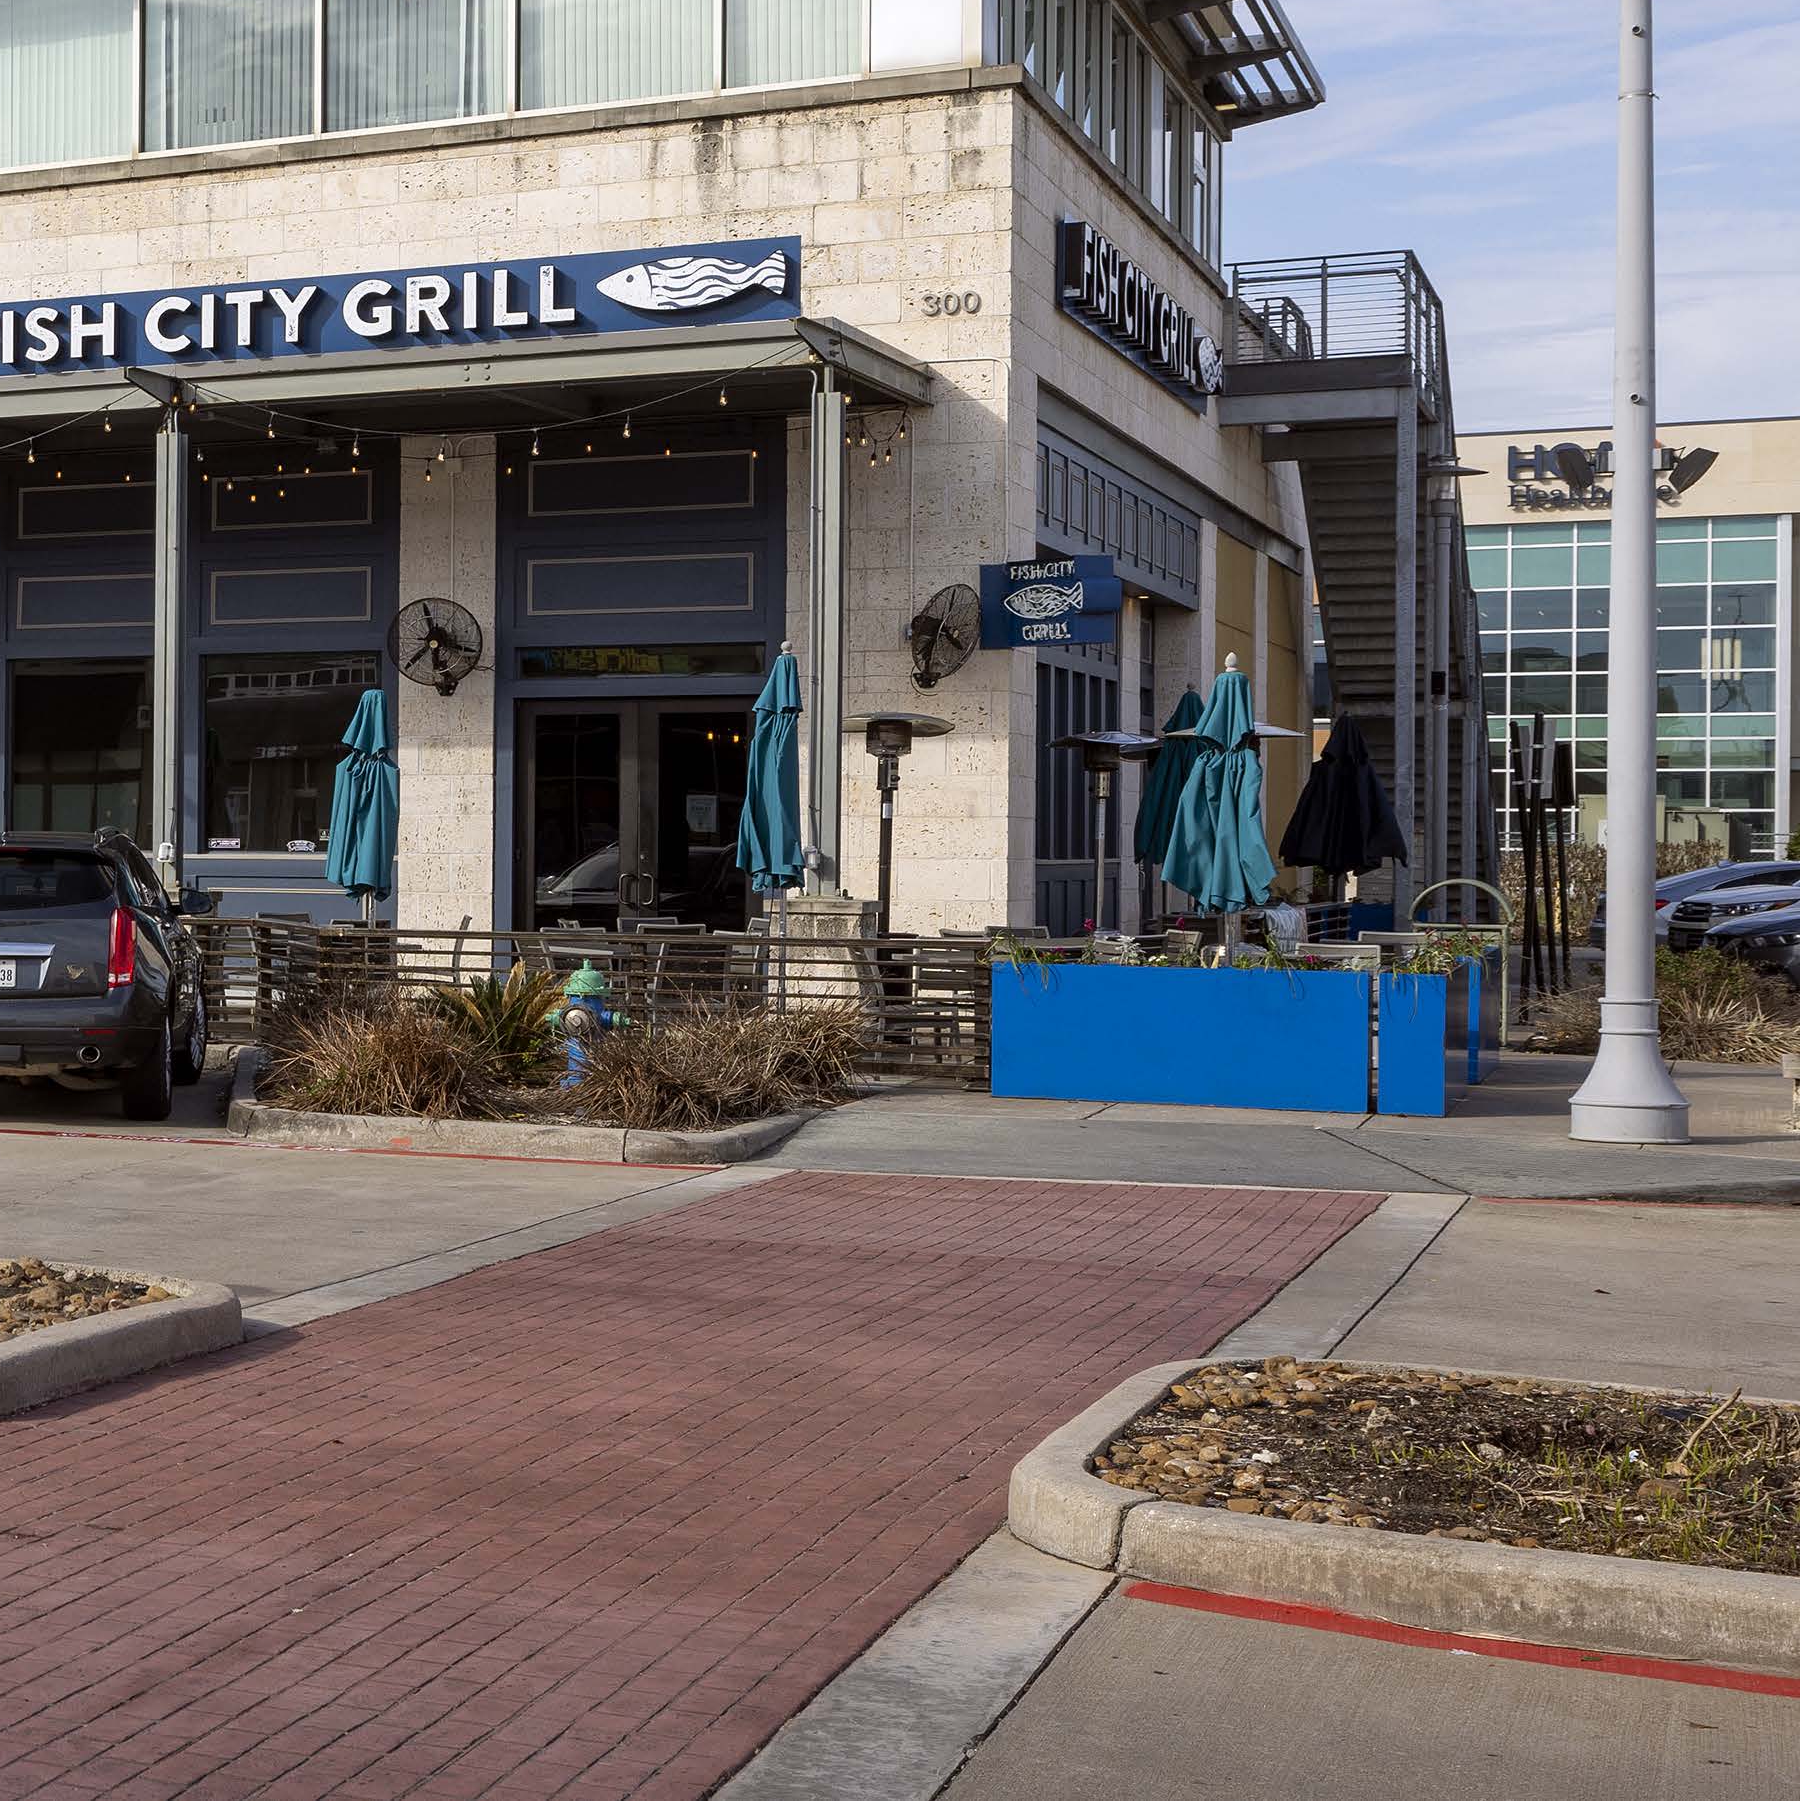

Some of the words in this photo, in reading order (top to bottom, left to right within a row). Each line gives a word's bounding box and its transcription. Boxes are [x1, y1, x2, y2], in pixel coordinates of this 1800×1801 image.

[144, 285, 318, 353] CITY
[342, 265, 576, 337] GRILL
[920, 290, 981, 316] 300
[1082, 222, 1120, 326] FISH
[1123, 260, 1158, 351] CITY
[1159, 292, 1197, 386] GRILL
